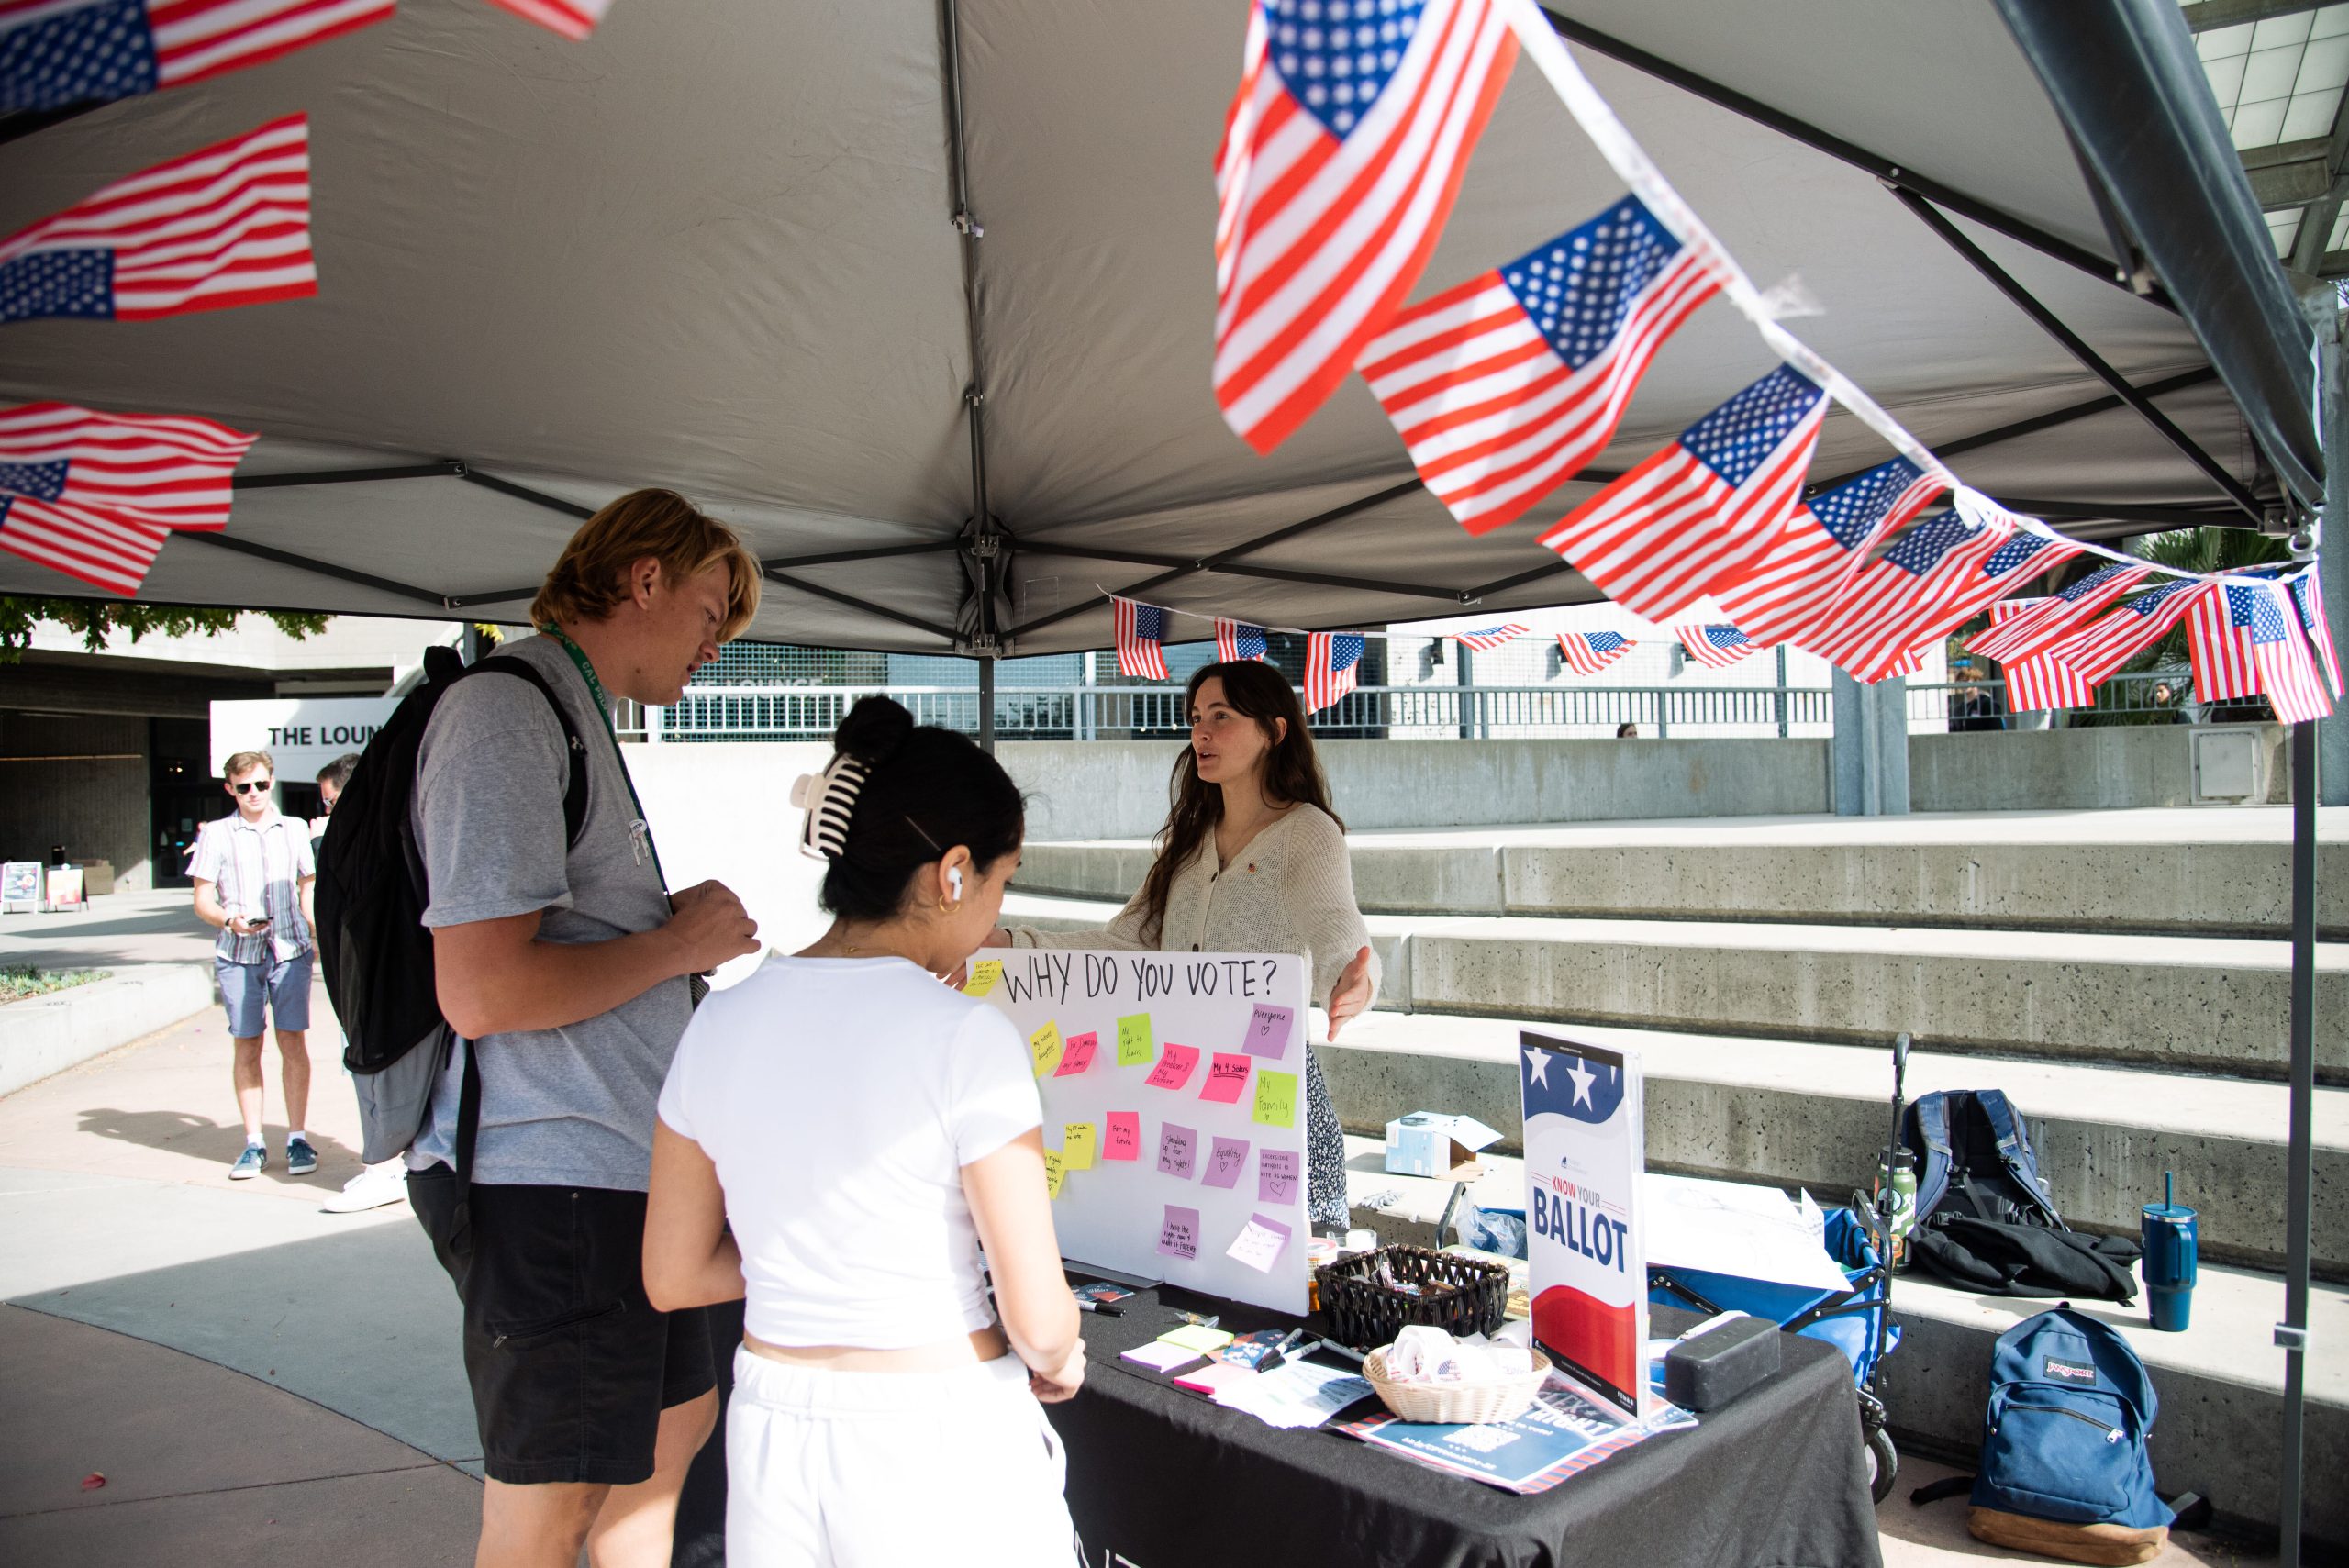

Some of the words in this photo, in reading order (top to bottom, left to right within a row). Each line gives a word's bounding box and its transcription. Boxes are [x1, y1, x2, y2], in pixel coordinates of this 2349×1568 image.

[582, 661, 596, 684] CAL
[268, 726, 312, 746] THE
[1002, 952, 1071, 1005] WHY
[1086, 953, 1118, 998] DO
[1132, 957, 1173, 1001] YOU
[1187, 960, 1277, 997] VOTE?
[1253, 1009, 1286, 1023] everyone
[1167, 1050, 1177, 1060] My
[1213, 1063, 1221, 1073] My
[1225, 1063, 1230, 1072] 4
[1260, 1077, 1271, 1092] My
[1259, 1097, 1289, 1118] Family
[1112, 1125, 1121, 1133] For
[1216, 1147, 1241, 1167] Equality
[1552, 1174, 1576, 1198] KNOW
[1577, 1184, 1601, 1208] YOUR
[1533, 1185, 1629, 1273] BALLOT
